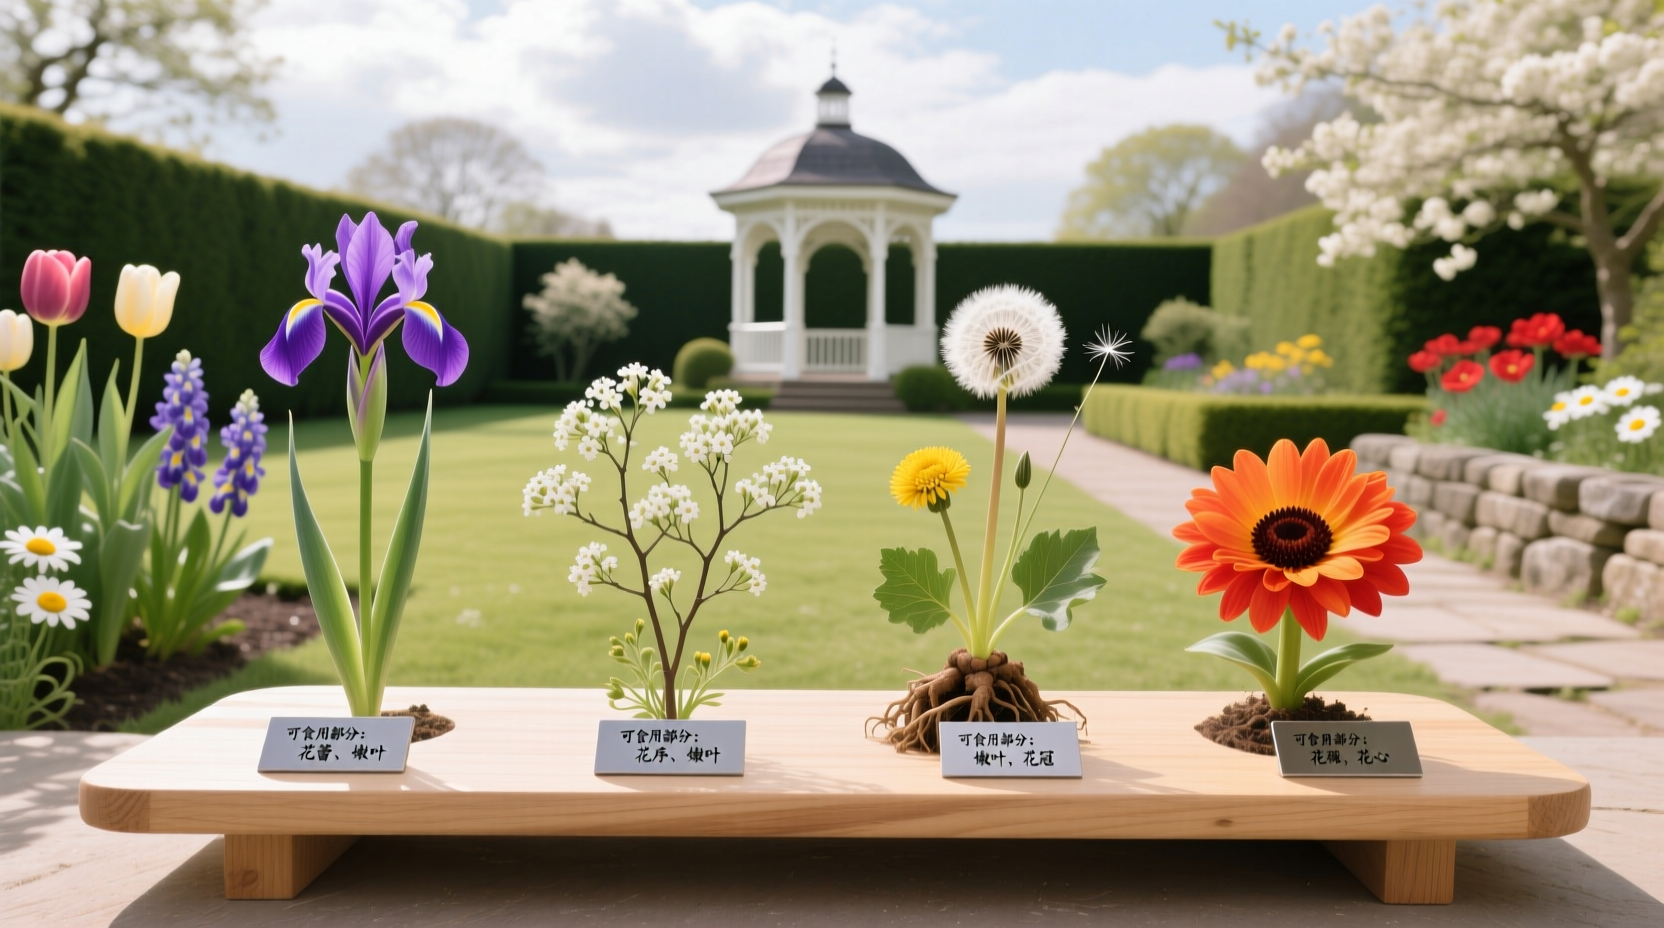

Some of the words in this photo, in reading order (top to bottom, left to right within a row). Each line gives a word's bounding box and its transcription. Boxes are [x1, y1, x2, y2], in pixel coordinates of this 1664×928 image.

[287, 725, 365, 741] 可食用部分：
